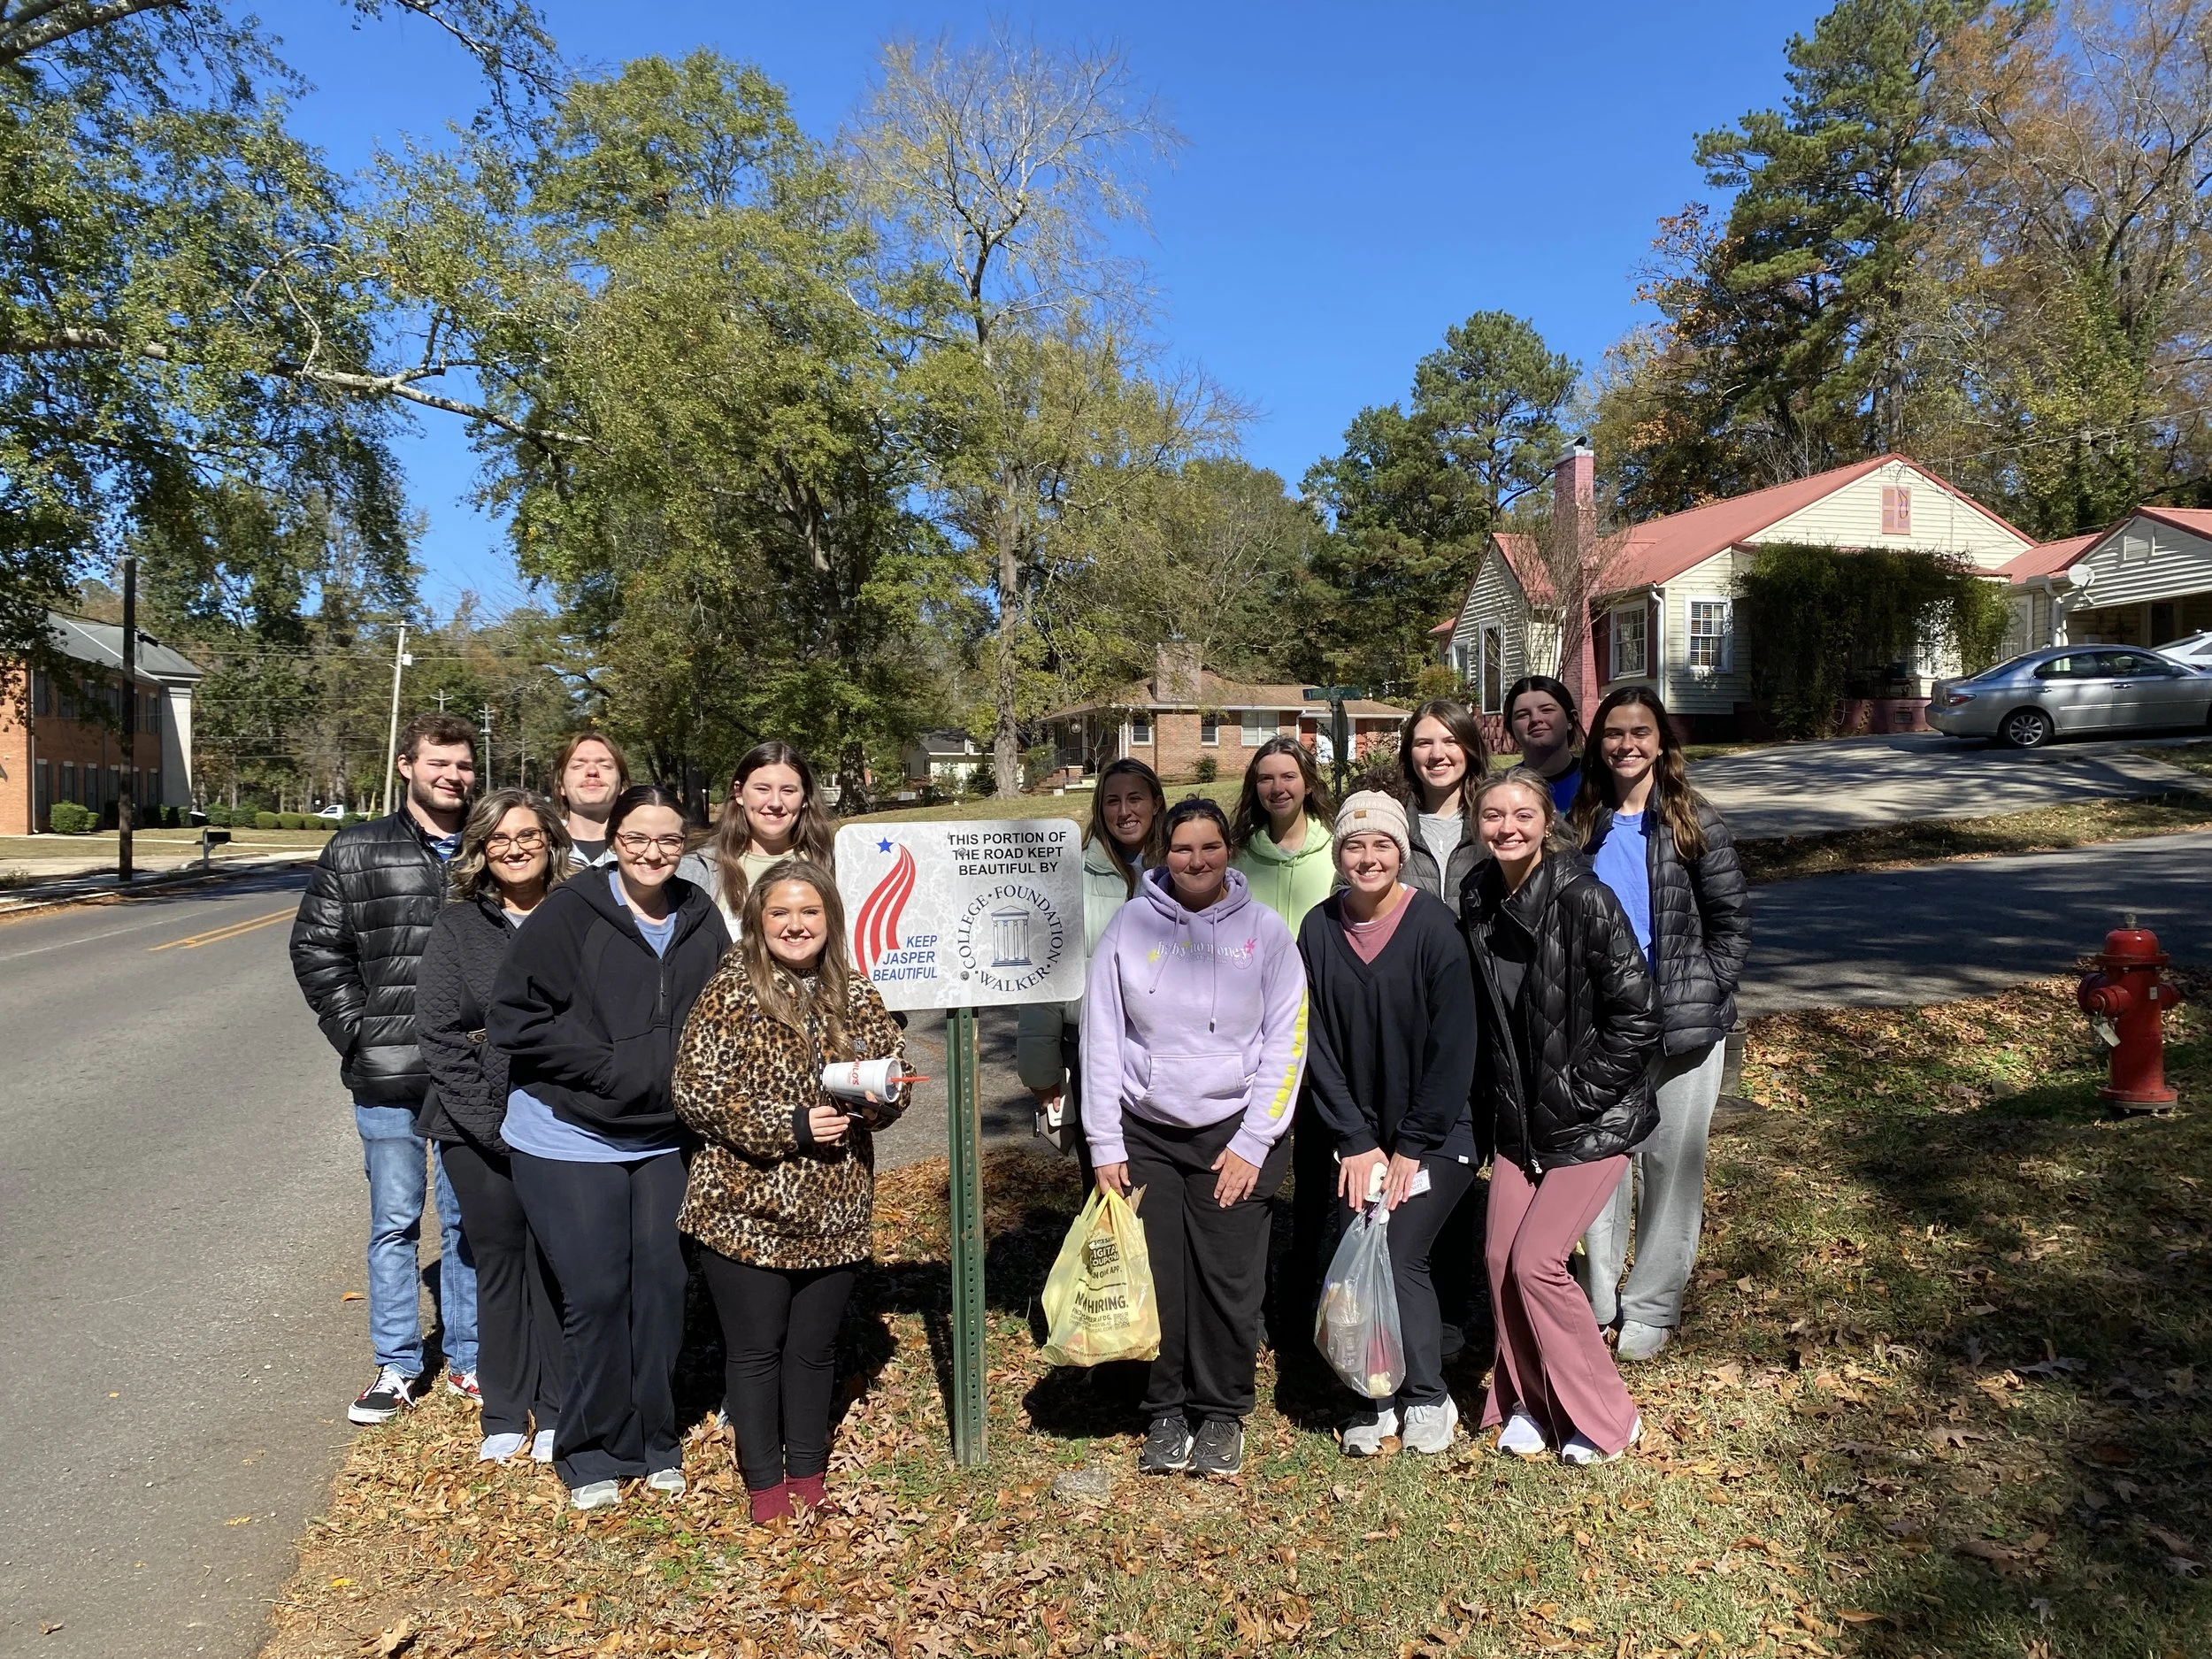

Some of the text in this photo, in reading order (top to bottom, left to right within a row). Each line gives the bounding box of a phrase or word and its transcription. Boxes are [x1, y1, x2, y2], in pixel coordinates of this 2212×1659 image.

[949, 832, 1067, 845] THIS PORTION OF
[952, 846, 1064, 860] THE ROAD KEPT
[959, 862, 1058, 875] BEAUTIFUL BY
[957, 884, 1064, 970] COLLEGE FOUNDATION
[906, 934, 938, 948] KEEP
[1190, 941, 1203, 954] no
[882, 951, 935, 965] JASPER
[872, 966, 938, 981] BEAUTIFUL
[980, 967, 1051, 992] WALKER
[1087, 1294, 1129, 1314] HIRING.
